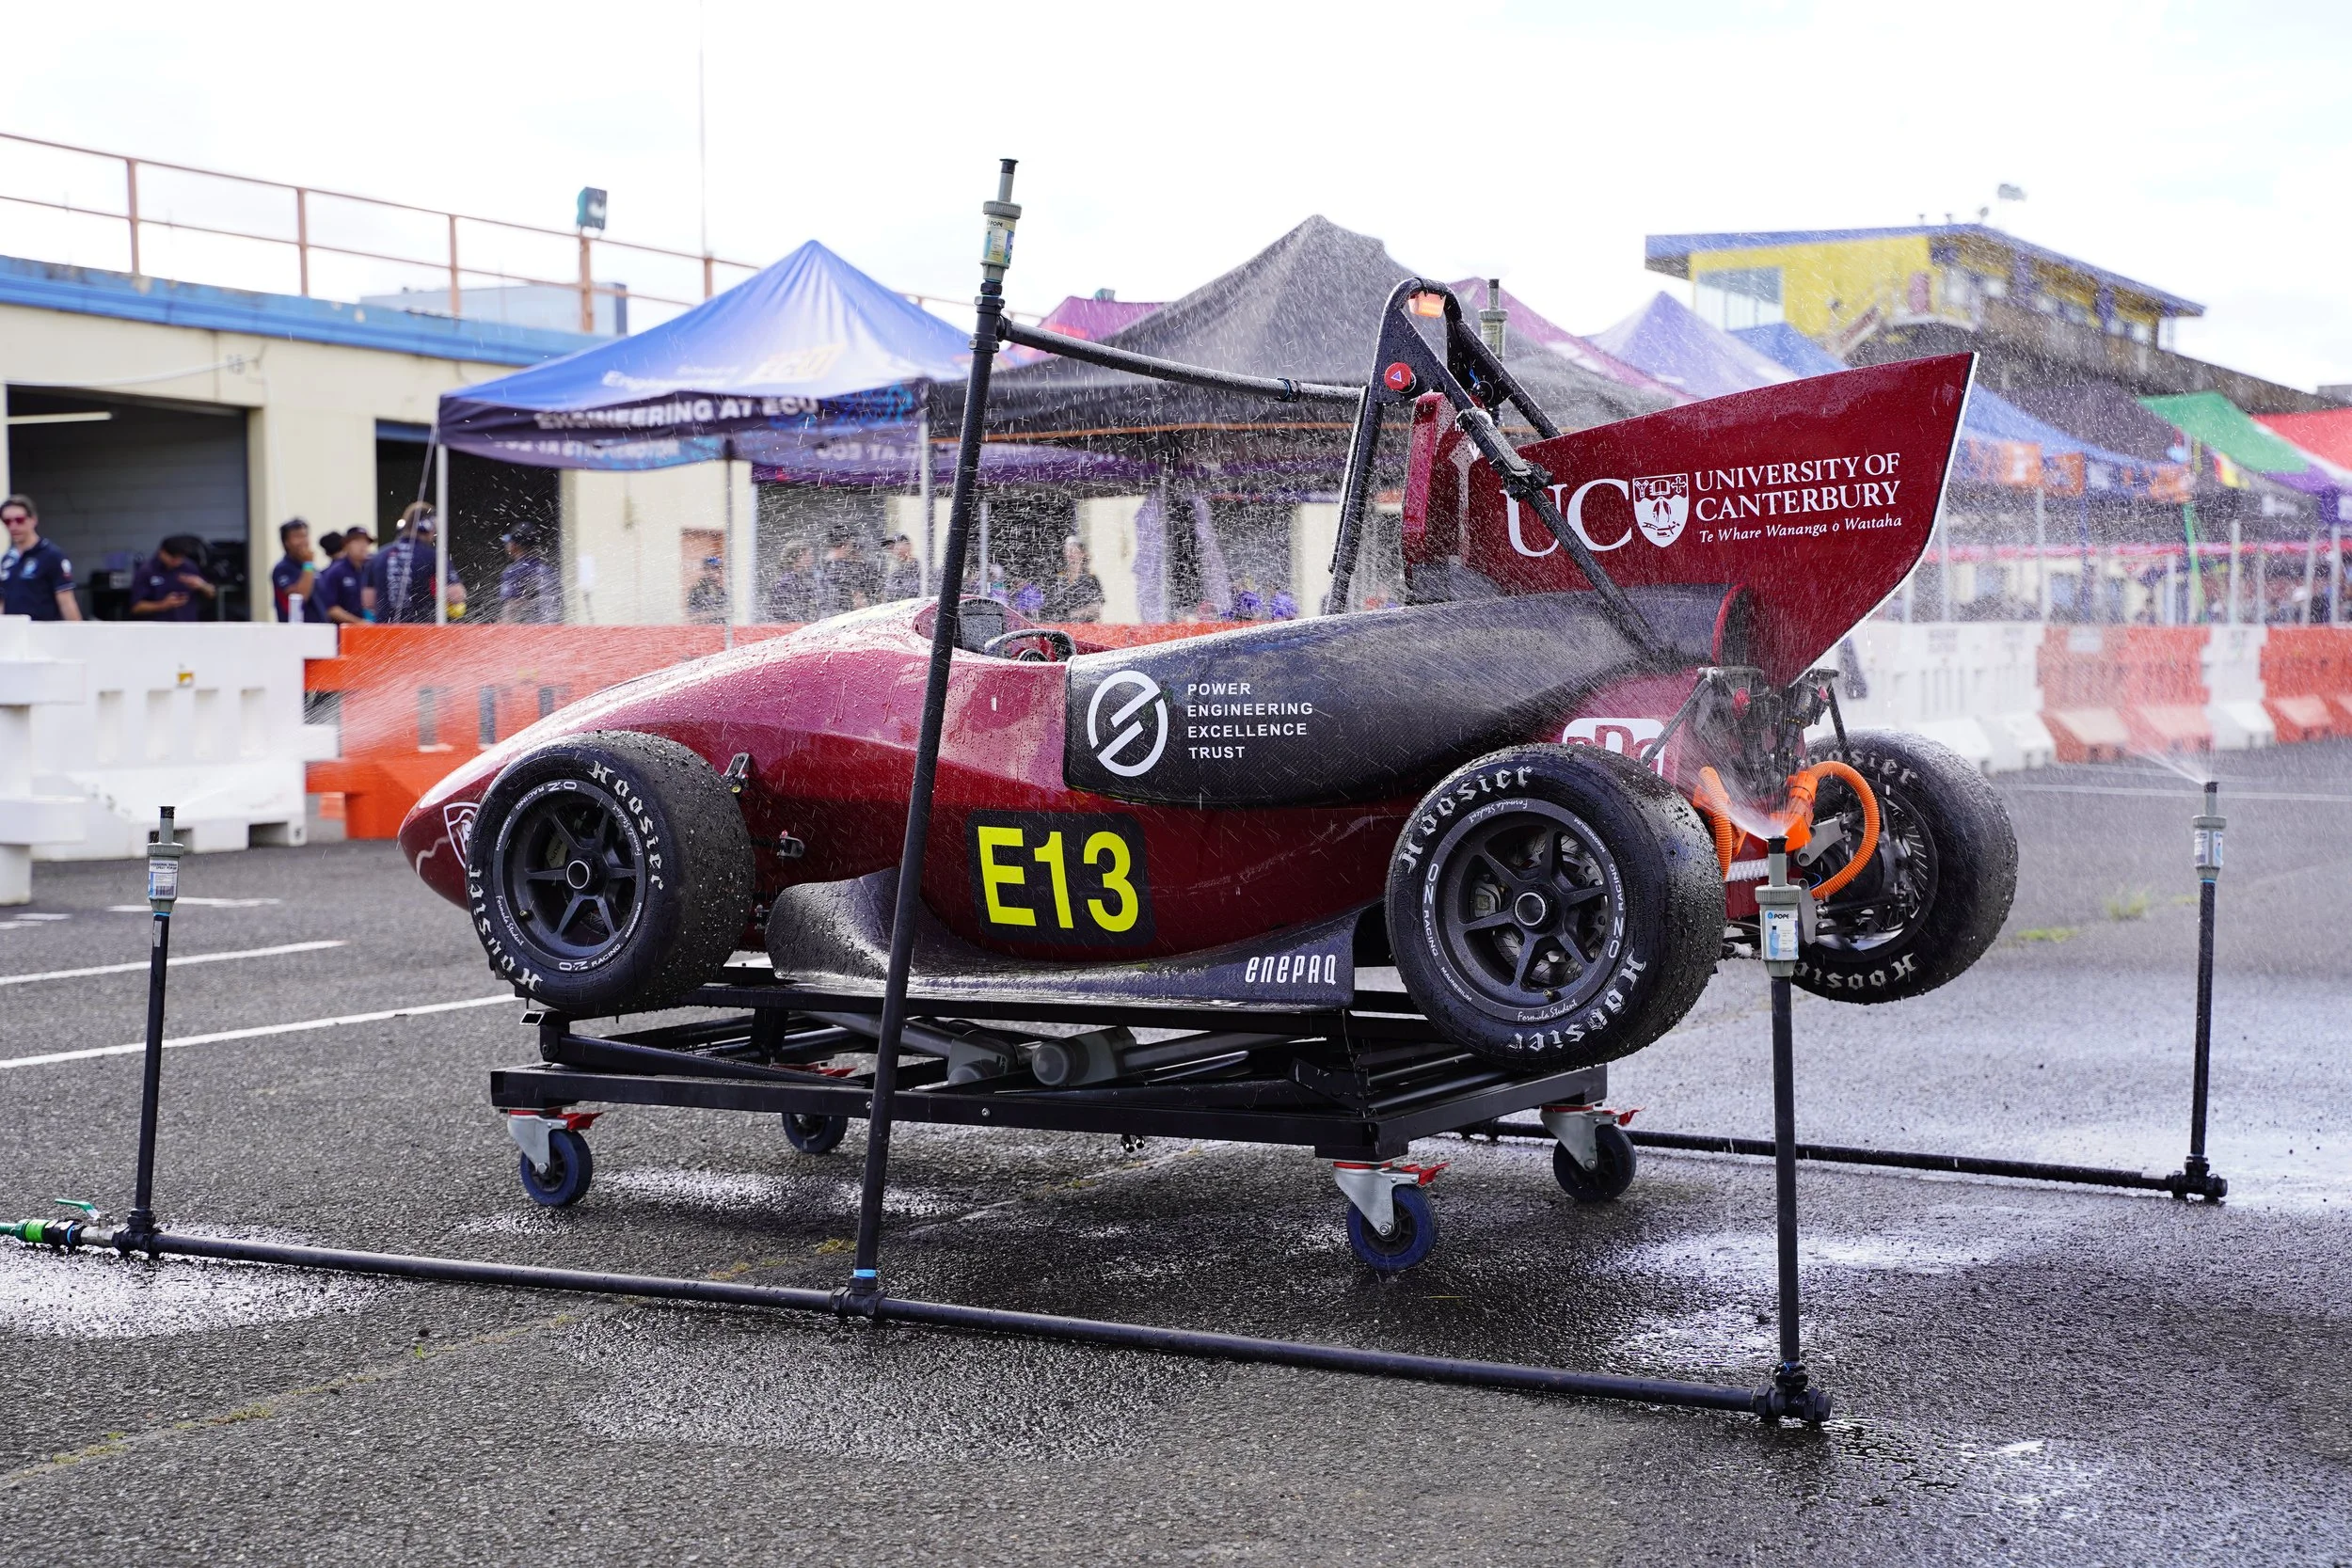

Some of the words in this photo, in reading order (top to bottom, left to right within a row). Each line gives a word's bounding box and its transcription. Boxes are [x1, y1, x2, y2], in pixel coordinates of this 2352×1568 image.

[533, 399, 712, 429] ENGINEERING
[719, 399, 753, 419] AT
[762, 396, 818, 416] ECU
[1695, 456, 1860, 491] UNIVERSITY
[1864, 452, 1900, 476] OF
[1500, 478, 1631, 557] UC
[1695, 481, 1900, 521] CANTERBURY
[1700, 531, 1713, 543] Te
[1718, 527, 1761, 542] Whare
[1766, 523, 1827, 537] Wananga
[1832, 522, 1839, 532] o
[1187, 683, 1251, 696] POWER
[1187, 703, 1313, 718] ENGINEERING
[1187, 723, 1308, 738] EXCELLENCE
[1188, 746, 1246, 759] TRUST
[516, 786, 545, 810] RACING
[1469, 804, 1496, 823] Student
[1496, 800, 1528, 811] Formula
[587, 760, 664, 890] Hoosier
[1398, 765, 1534, 874] Hoosier
[1573, 817, 1607, 853] MAGNESIUM
[977, 826, 1139, 933] E13
[1608, 863, 1624, 911] RACING
[469, 863, 543, 991] Hoosier
[506, 922, 524, 946] Student
[1423, 910, 1438, 957] RACING
[591, 943, 621, 967] RACING
[1793, 952, 1918, 990] Hoosie
[1508, 948, 1646, 1052] Hoosier
[1518, 1010, 1549, 1022] Formula
[1549, 999, 1578, 1017] Student
